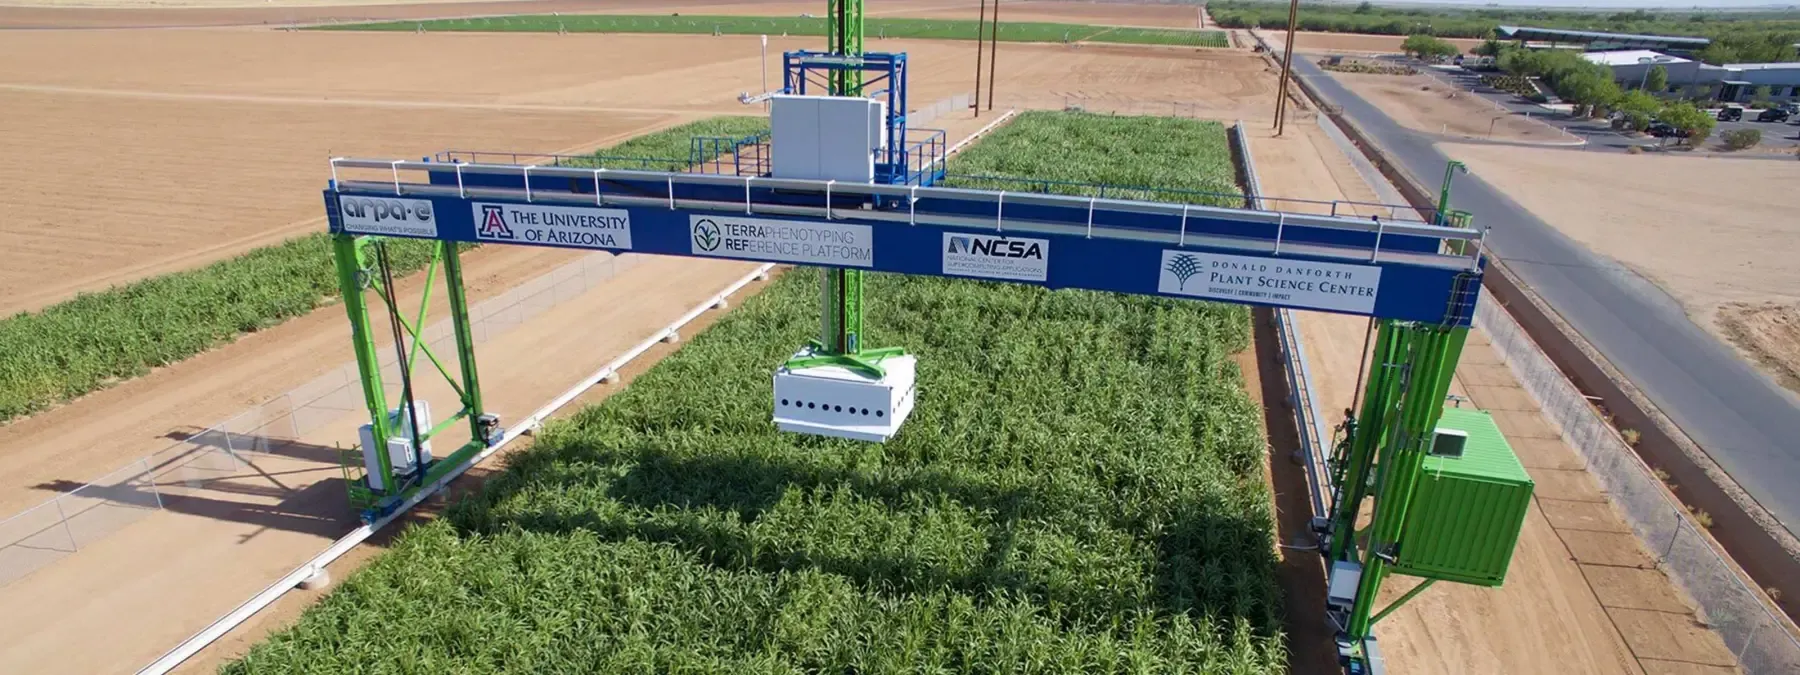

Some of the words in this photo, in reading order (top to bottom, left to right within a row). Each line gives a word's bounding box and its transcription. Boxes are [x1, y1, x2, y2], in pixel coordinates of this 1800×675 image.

[478, 204, 514, 239] A
[511, 210, 538, 225] THE
[543, 212, 627, 230] UNIVERSITY
[525, 229, 543, 242] OF
[547, 229, 617, 246] ARIZONA
[803, 244, 871, 261] PLATFORM
[971, 238, 1042, 260] NCSA
[1211, 260, 1267, 273] DONALD
[1275, 266, 1353, 280] DANFORTH
[1210, 271, 1253, 286] PLANT
[1257, 276, 1314, 292] SCIENCE
[1319, 281, 1374, 297] CENTER
